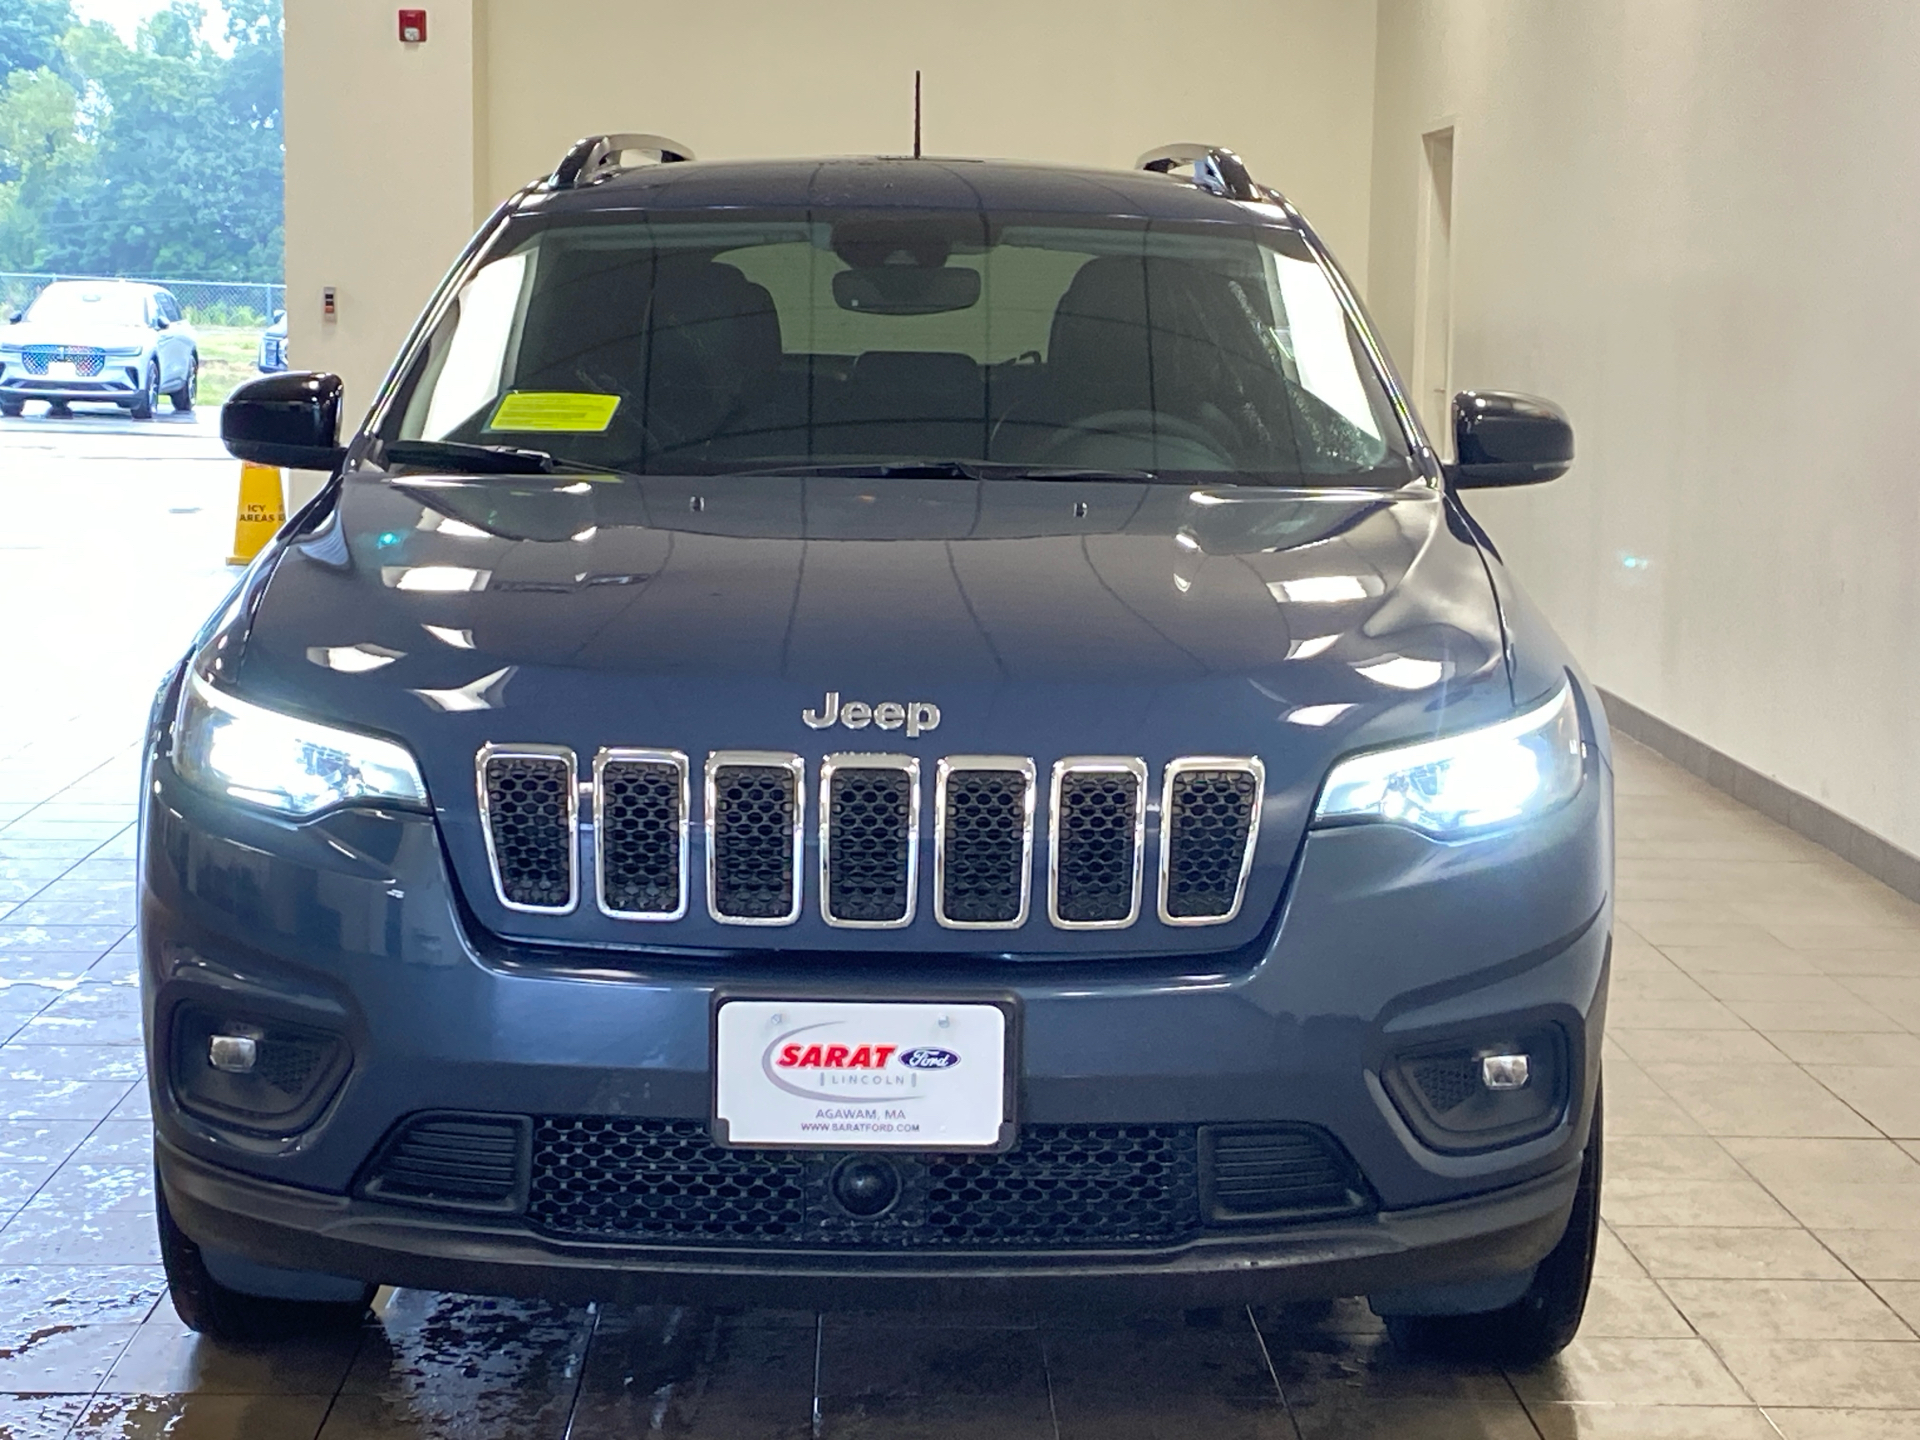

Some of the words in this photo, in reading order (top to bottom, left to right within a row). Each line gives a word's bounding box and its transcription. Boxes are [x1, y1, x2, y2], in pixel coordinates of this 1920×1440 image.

[247, 504, 266, 512] ICY
[240, 513, 275, 522] AREAS
[802, 691, 941, 738] Jeep
[775, 1043, 897, 1069] SARAT
[908, 1049, 951, 1068] Ford
[831, 1074, 905, 1086] LINCOLN
[884, 1109, 907, 1121] MA
[801, 1122, 920, 1133] WWW.SARATFORD.COM
